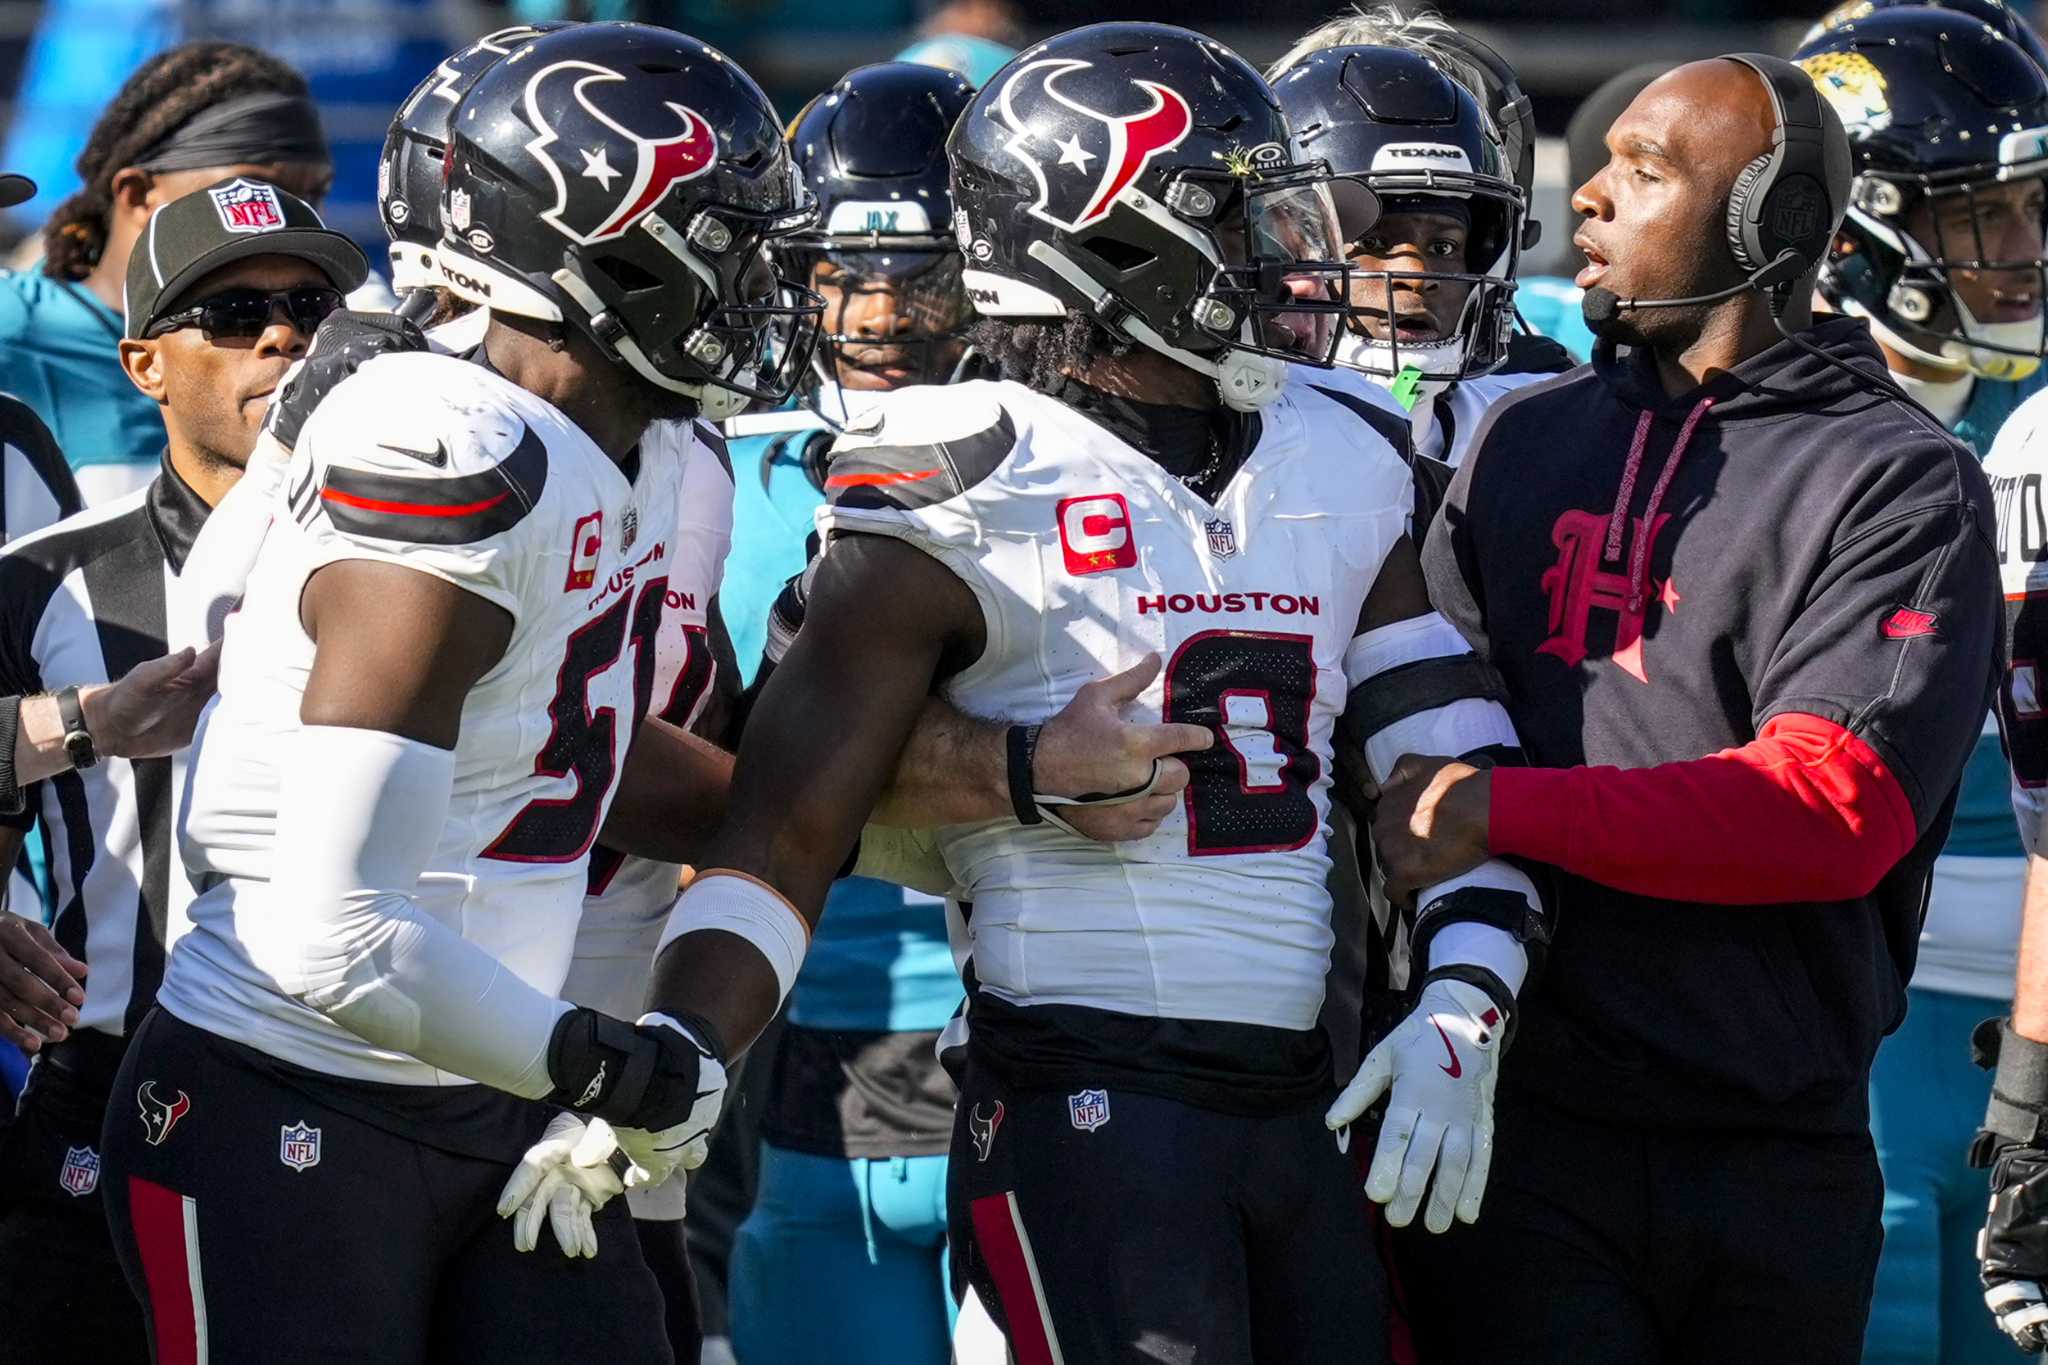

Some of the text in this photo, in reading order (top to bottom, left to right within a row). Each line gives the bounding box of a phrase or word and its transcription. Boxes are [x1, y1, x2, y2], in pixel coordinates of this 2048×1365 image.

[1387, 148, 1463, 160] TEXANS
[222, 201, 280, 226] NFL
[861, 210, 899, 232] JAX
[1064, 498, 1128, 555] C
[1209, 535, 1235, 552] NFL
[1137, 592, 1320, 616] HOUSTON
[1162, 628, 1321, 857] 0
[1076, 1104, 1104, 1123] NFL
[286, 1142, 315, 1162] NFL
[64, 1166, 93, 1192] NFL
